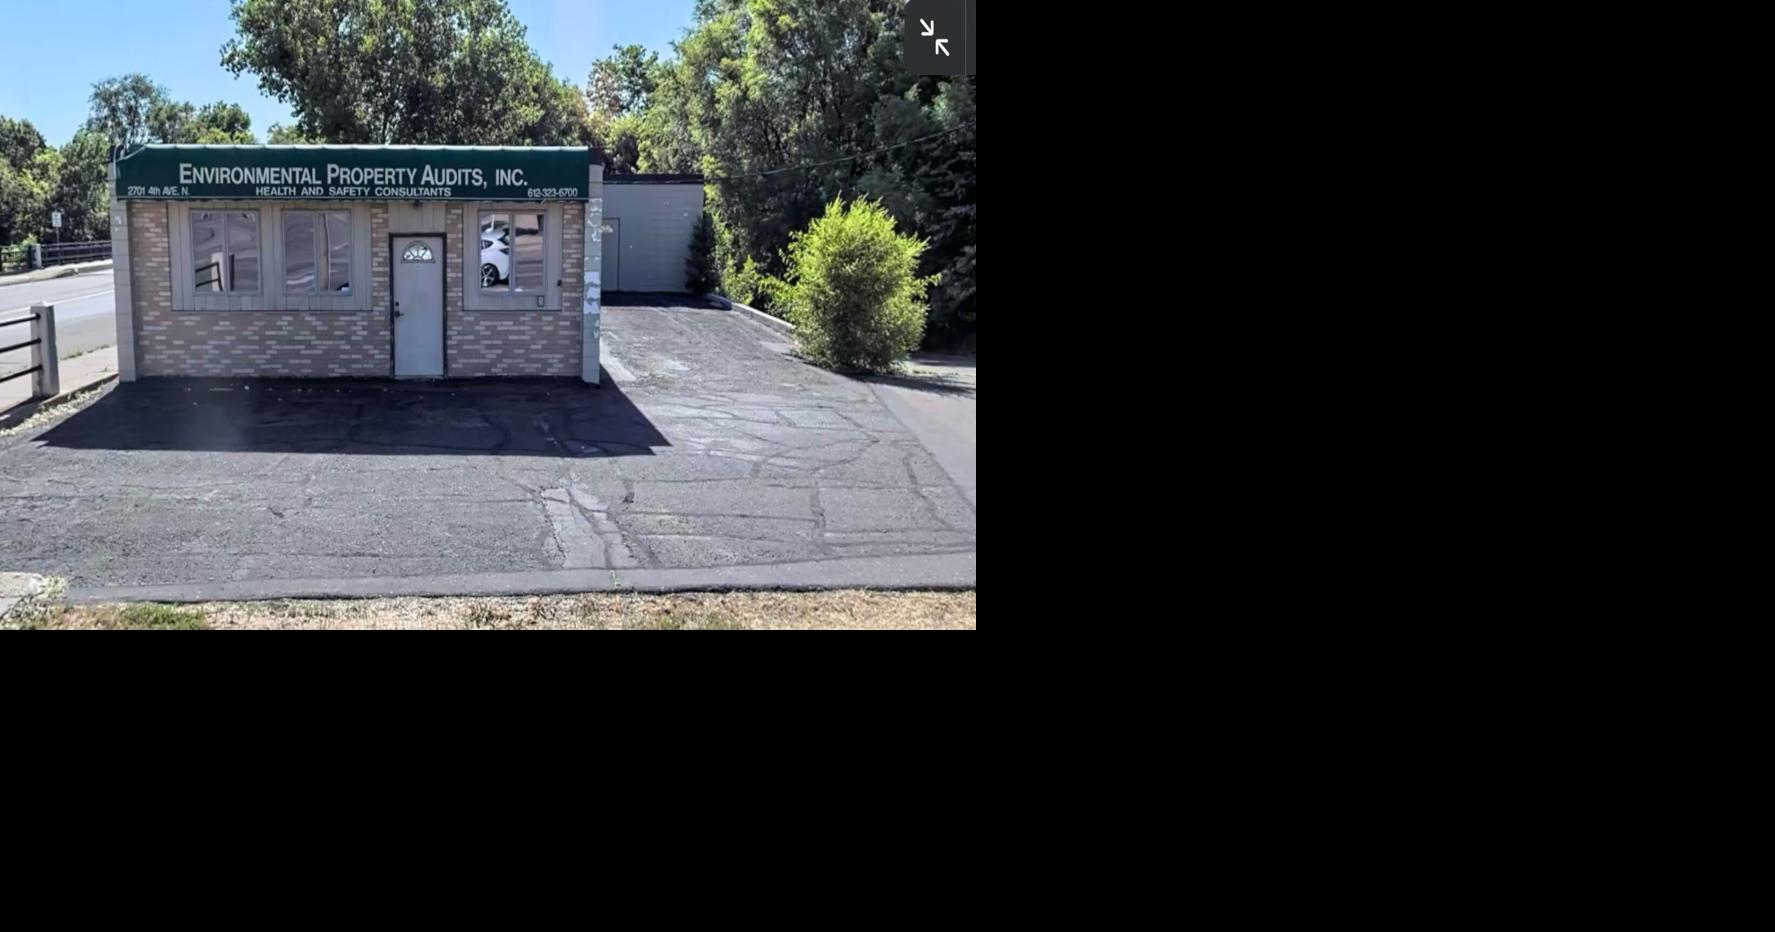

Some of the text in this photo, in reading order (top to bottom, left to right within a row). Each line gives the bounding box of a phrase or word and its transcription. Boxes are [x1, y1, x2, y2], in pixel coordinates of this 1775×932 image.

[179, 163, 528, 189] ENVIRONMENTAL PROPERTY AUDITS, INC.
[127, 186, 146, 196] 2701
[148, 186, 160, 196] 4th
[255, 186, 452, 197] HEALTH AND SAFETY CONSULTANTS
[527, 187, 578, 198] 612-323-6700
